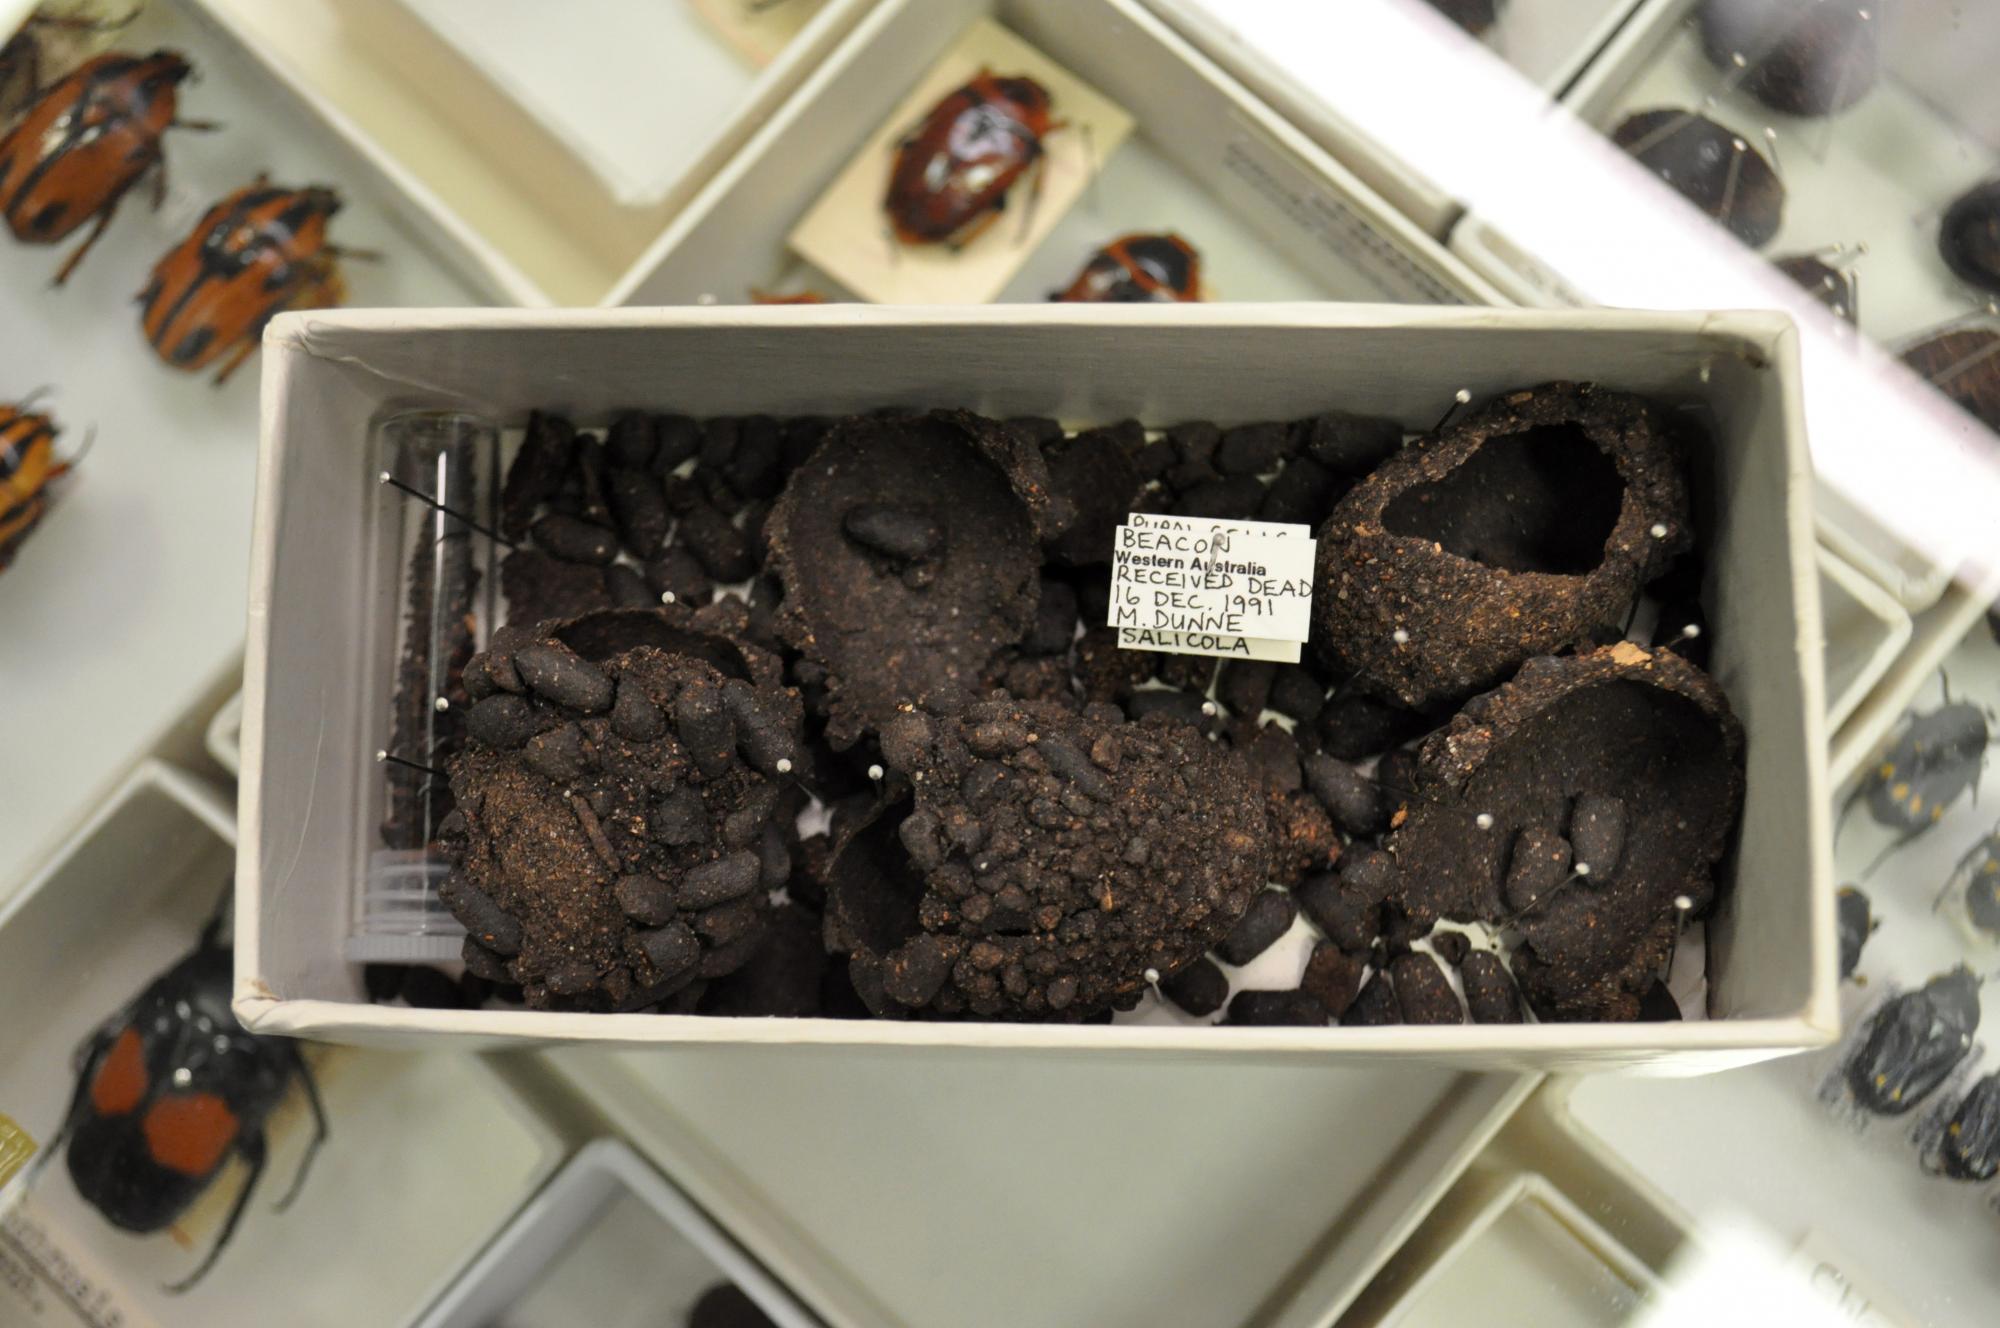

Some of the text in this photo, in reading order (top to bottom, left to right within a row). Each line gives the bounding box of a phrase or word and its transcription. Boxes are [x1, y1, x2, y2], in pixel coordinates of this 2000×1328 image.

[1123, 527, 1231, 554] BEACON
[1115, 550, 1184, 569] Western
[1117, 564, 1314, 598] RECEIVED DEAD
[1115, 584, 1274, 616] 16 DEC. 1991
[1122, 627, 1250, 655] SALICOLA
